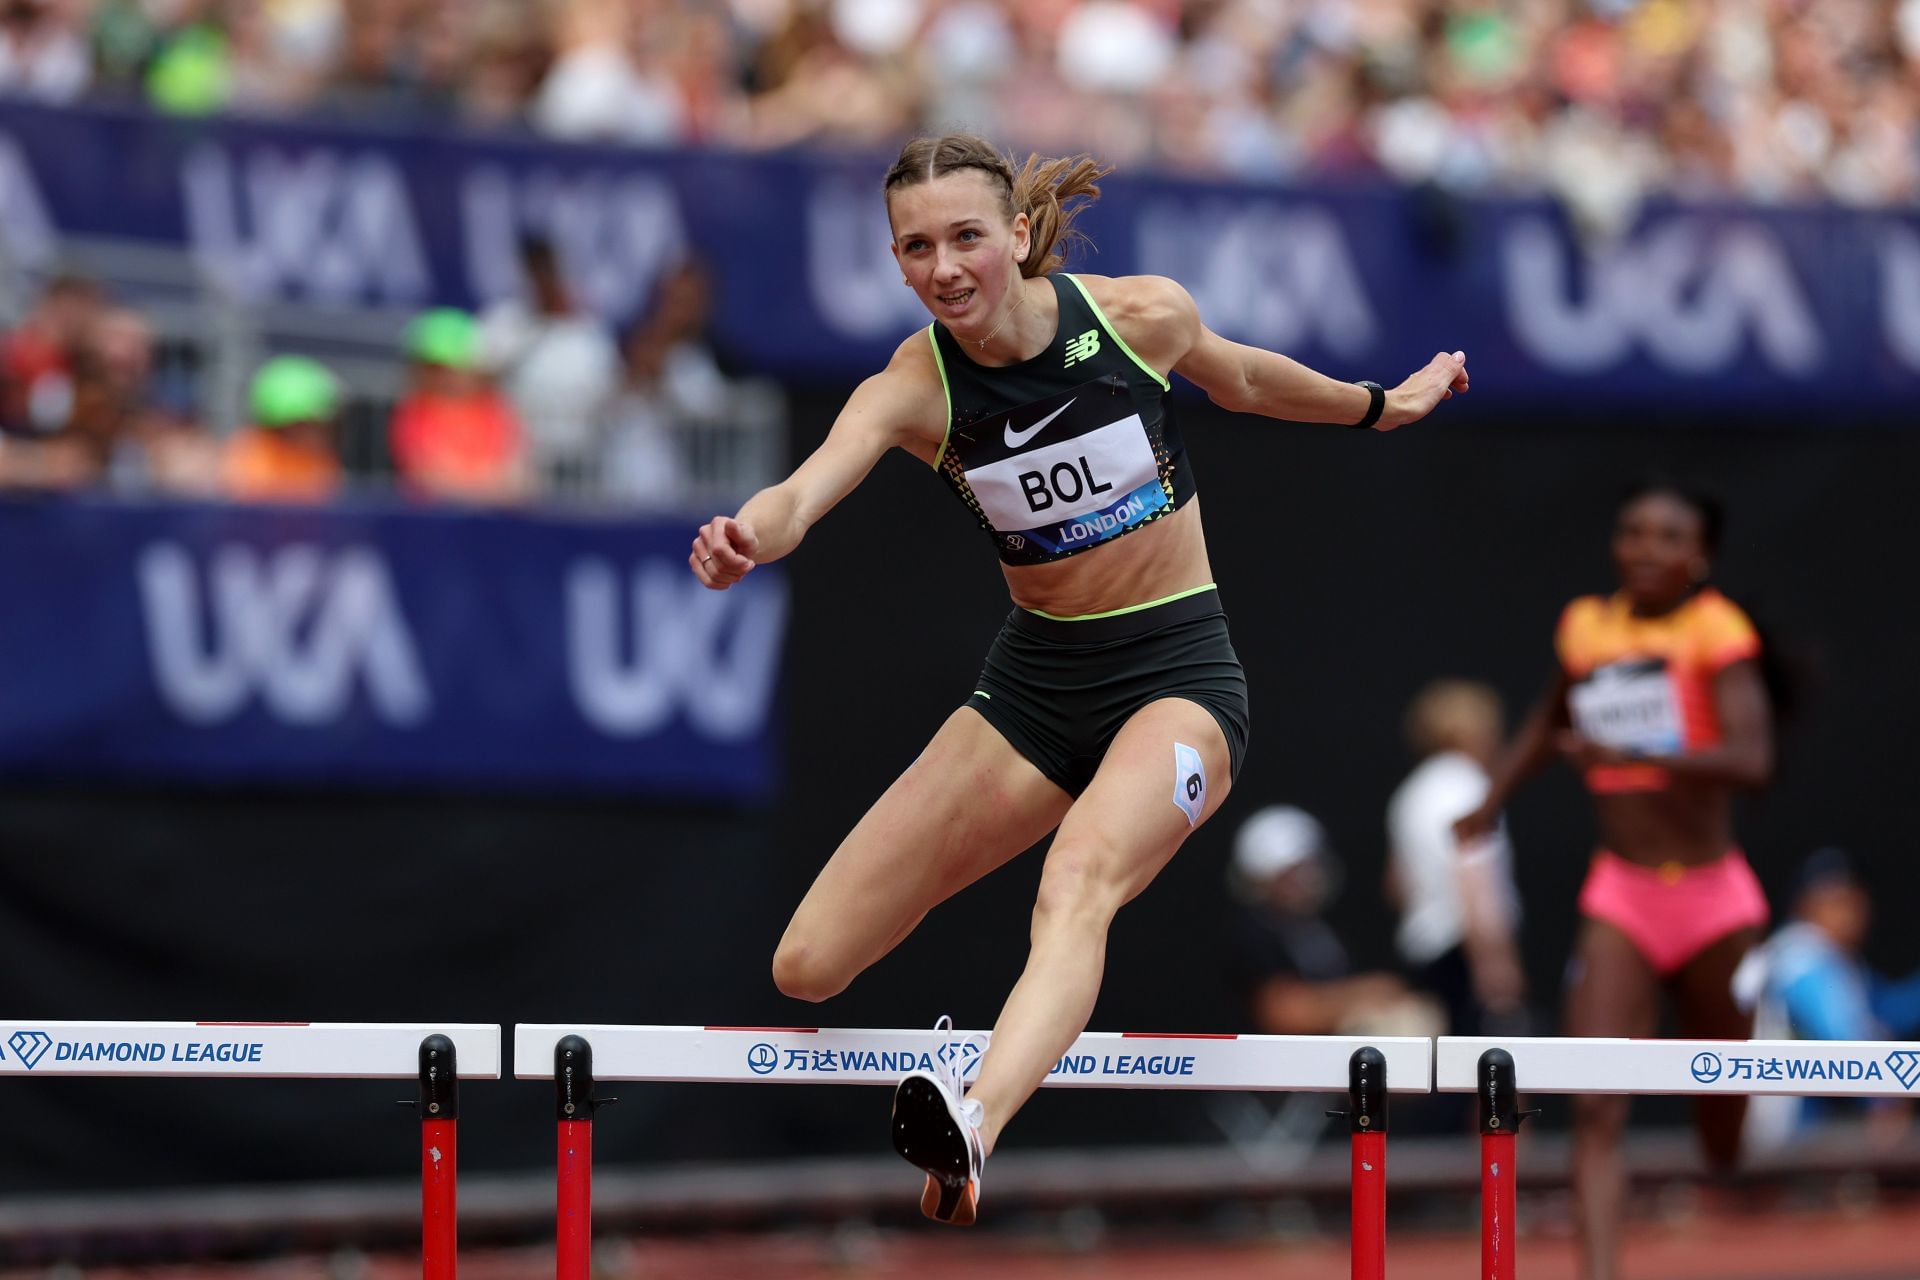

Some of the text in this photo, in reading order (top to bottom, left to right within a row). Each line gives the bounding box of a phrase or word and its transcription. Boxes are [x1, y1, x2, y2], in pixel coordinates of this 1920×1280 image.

[1018, 456, 1113, 512] BOL
[1059, 496, 1145, 543] LONDON
[1186, 773, 1203, 802] 6
[55, 1042, 263, 1063] DIAMOND LEAGUE
[1102, 1055, 1195, 1075] LEAGUE
